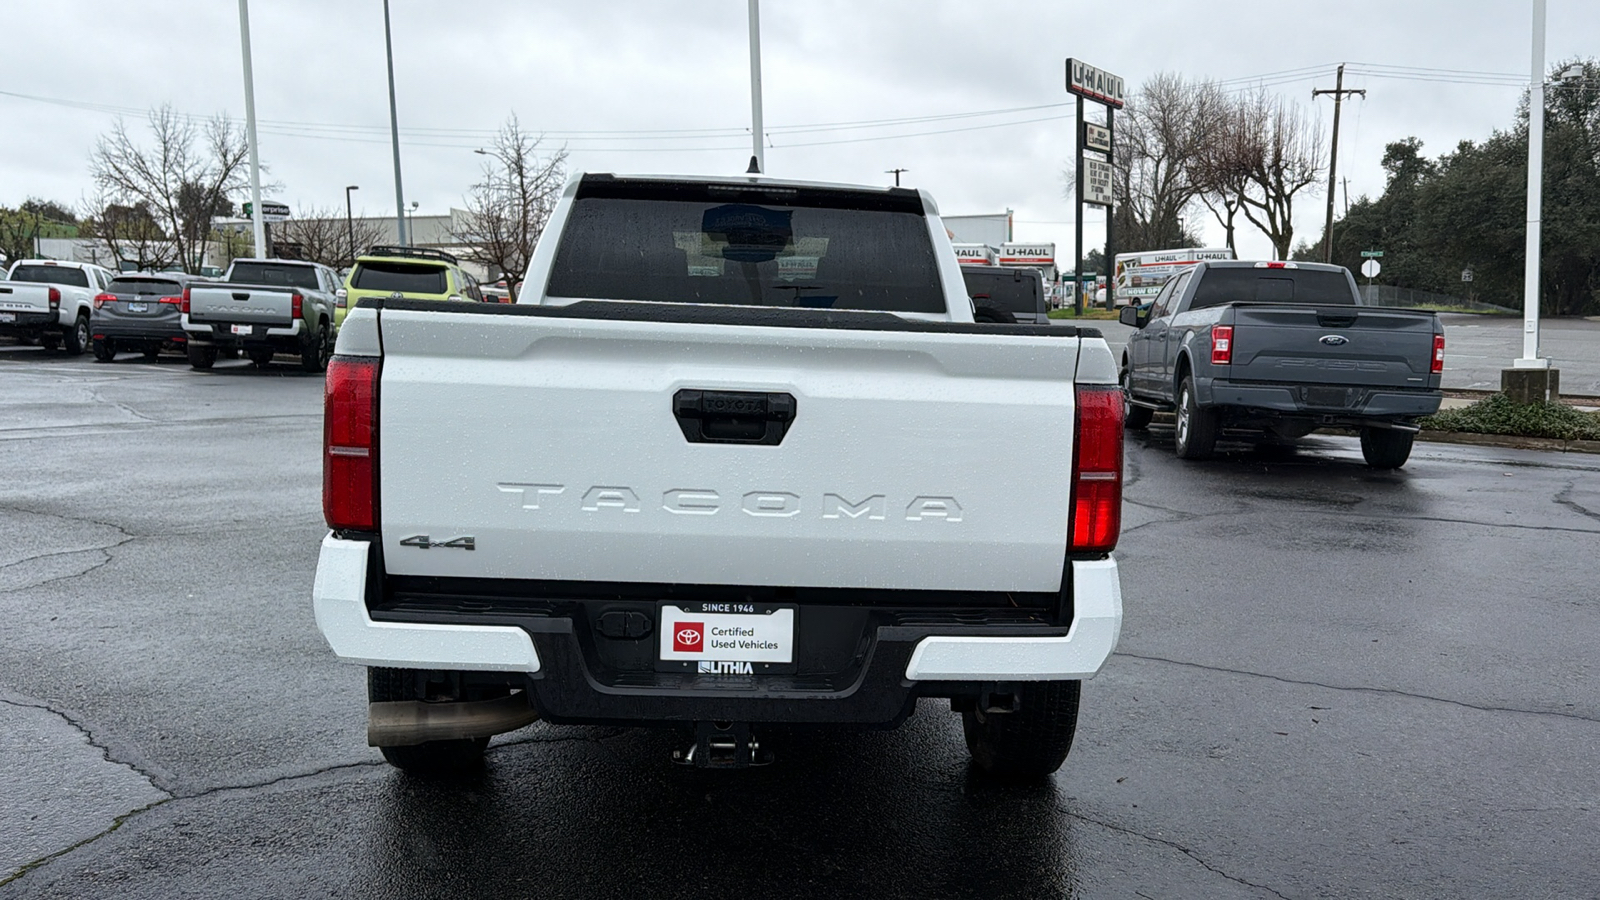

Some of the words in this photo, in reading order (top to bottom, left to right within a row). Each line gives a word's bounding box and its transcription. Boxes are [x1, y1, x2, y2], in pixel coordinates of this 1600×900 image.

[1074, 64, 1123, 99] U-HAUL
[955, 249, 982, 257] HAUL
[1006, 248, 1049, 256] U-HAUL
[1155, 254, 1178, 262] U-HAUL
[206, 304, 276, 314] TACOMA
[706, 399, 764, 412] TOYOTA
[496, 482, 963, 522] TACOMA
[702, 603, 730, 612] SINCE
[733, 604, 754, 613] 1946
[711, 627, 754, 637] Certified
[711, 640, 736, 649] Used
[739, 640, 778, 650] Vehicles
[710, 661, 753, 674] LITHIA
